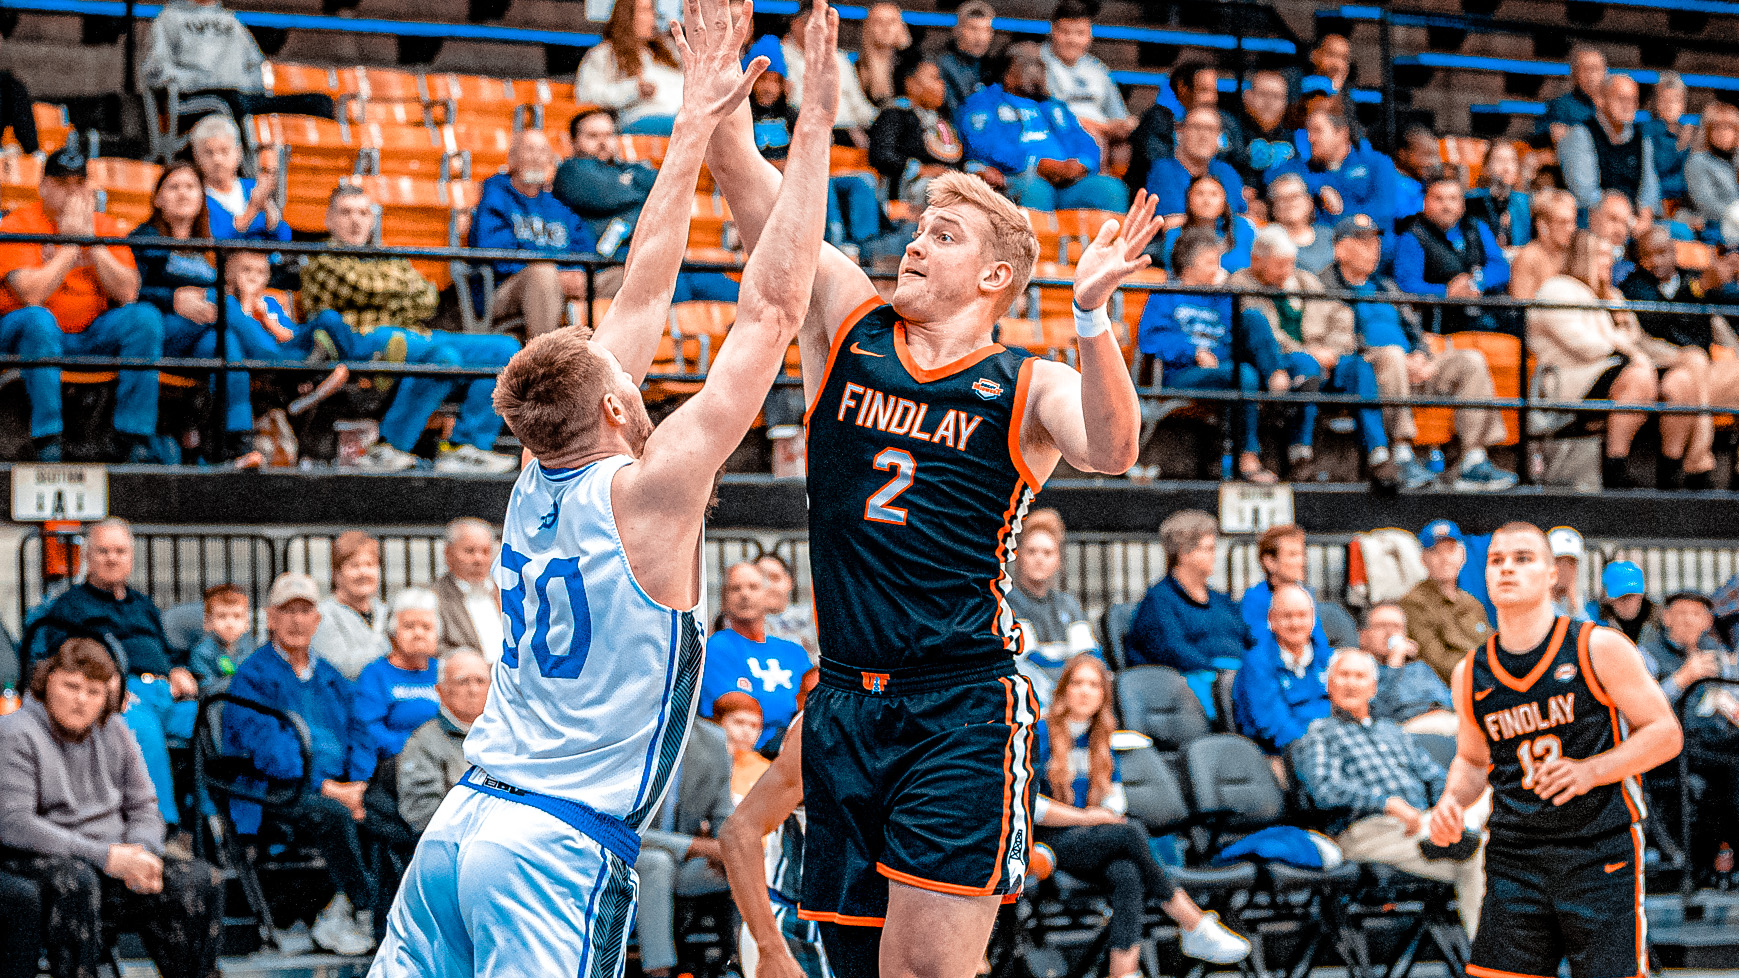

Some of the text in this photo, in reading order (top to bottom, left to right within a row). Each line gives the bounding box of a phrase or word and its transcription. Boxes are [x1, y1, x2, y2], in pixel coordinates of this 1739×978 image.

[837, 381, 983, 451] FINDLAY
[864, 446, 917, 525] 2
[500, 542, 592, 679] 30
[746, 656, 793, 693] UK
[861, 671, 890, 692] UF
[1484, 692, 1575, 741] FINDLAY
